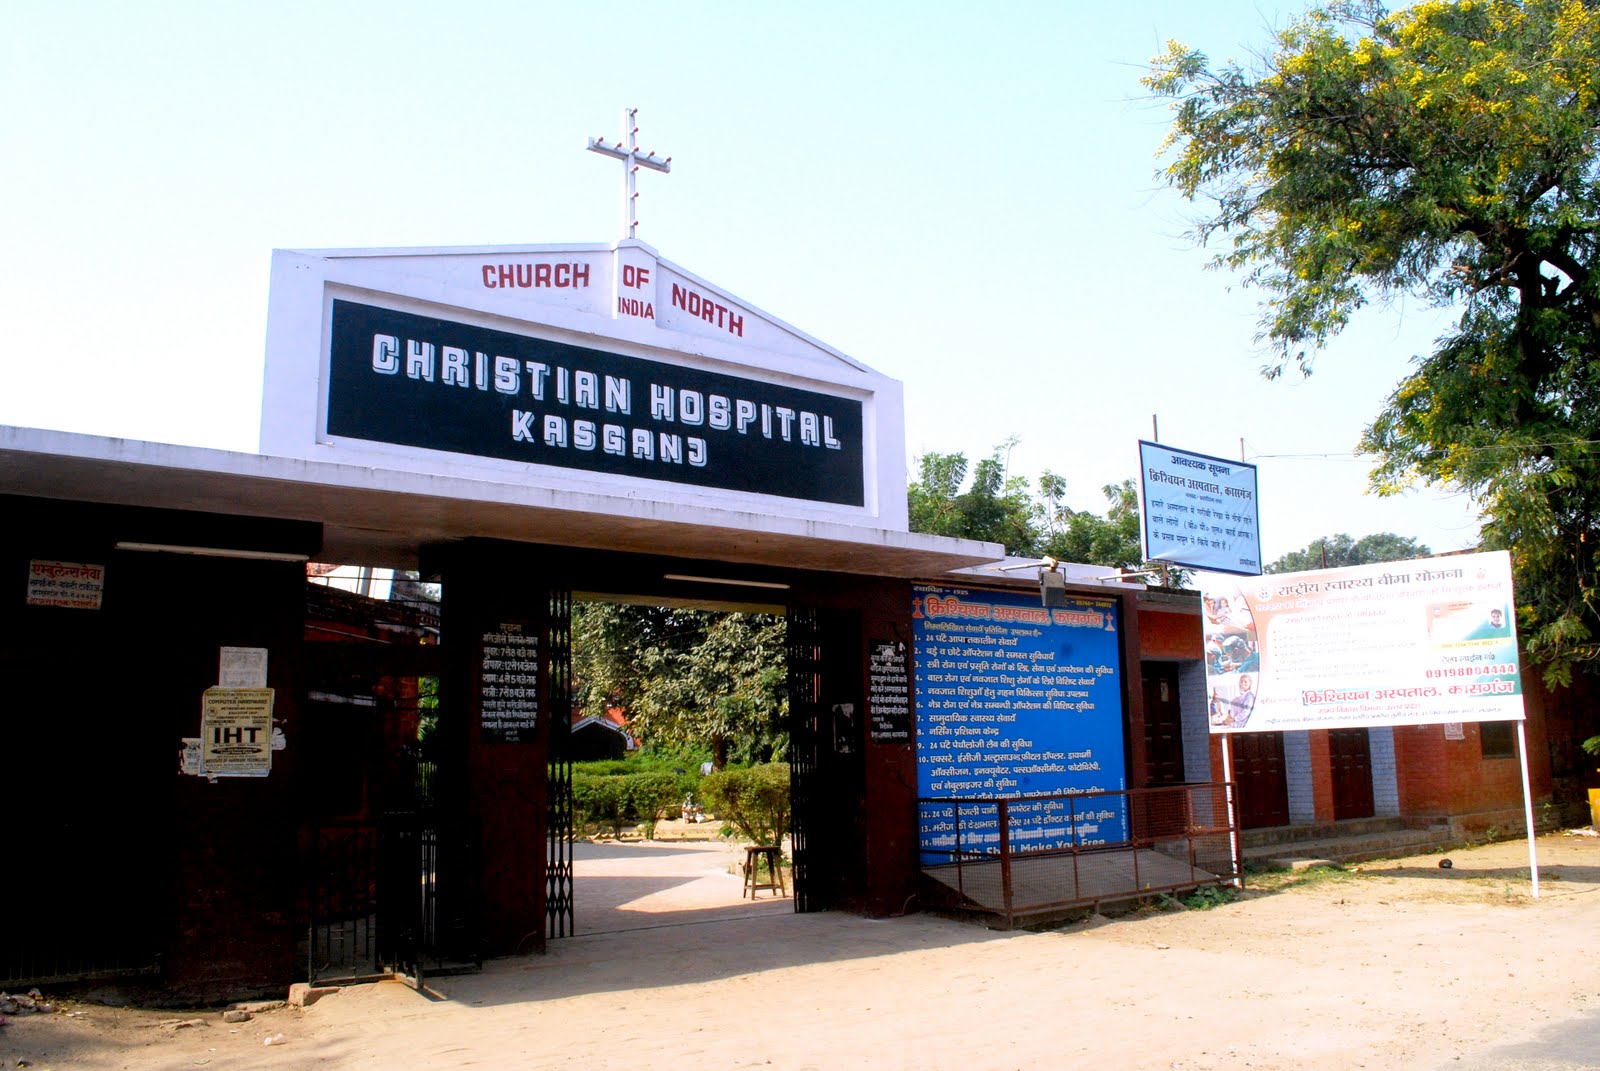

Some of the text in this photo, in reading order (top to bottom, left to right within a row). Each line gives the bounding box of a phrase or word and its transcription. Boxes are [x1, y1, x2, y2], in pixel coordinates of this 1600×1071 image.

[482, 263, 744, 338] CHURCH OF NORTH
[618, 296, 655, 320] INDIA
[371, 332, 842, 450] CHRISTIAN HOSPITAL
[511, 409, 708, 467] KASGANJ
[1171, 456, 1230, 477] आवश्यक सूचना
[1224, 487, 1252, 500] कासगंज
[1278, 568, 1463, 597] राष्ट्रीय स्वास्थ्य बीमा योजना
[925, 596, 991, 619] क्रिश्चियन
[1053, 609, 1103, 627] कासगंज
[947, 646, 960, 656] छोटे
[962, 647, 993, 658] ऑपरेशन
[994, 648, 1004, 658] की
[1006, 651, 1027, 660] समस्त
[927, 658, 940, 669] स्त्री
[942, 661, 955, 669] रोग
[957, 660, 968, 669] एवं
[970, 660, 990, 672] प्रसूति
[1007, 662, 1015, 671] के
[1032, 664, 1045, 673] सेवा
[1046, 664, 1057, 673] एवं
[1085, 664, 1094, 674] की
[1095, 665, 1114, 677] सुविधा
[1426, 664, 1516, 679] 09198004444
[927, 674, 943, 682] बाल
[944, 673, 958, 682] रोग
[960, 673, 971, 682] एवं
[972, 675, 998, 684] नवजात
[1000, 674, 1016, 687] शिशु
[1032, 676, 1041, 685] के
[1055, 676, 1078, 686] विशिष्ट
[928, 688, 956, 696] नवजात
[984, 687, 995, 700] हेतु
[997, 689, 1014, 697] गहन
[1016, 688, 1044, 698] चिकित्सा
[1045, 688, 1065, 701] सुविधा
[1304, 688, 1370, 704] क्रिश्चियन
[1448, 679, 1514, 695] कासगंज
[928, 700, 941, 709] नेत्र
[943, 700, 957, 709] रोग
[958, 700, 969, 709] एवं
[970, 700, 983, 709] नेत्र
[1042, 701, 1052, 710] की
[1053, 701, 1075, 711] विशिष्ट
[1075, 701, 1095, 713] सुविधा
[929, 712, 968, 726] सामुदायिक
[970, 714, 995, 722] स्वास्थ्य
[215, 727, 262, 743] IHT
[917, 725, 999, 737] 8. नर्सिंग प्रशिक्षण केन्द्र
[1000, 738, 1010, 748] की
[1011, 738, 1033, 751] सुविधा
[957, 752, 982, 763] ईसीजी
[931, 780, 944, 790] एवं
[983, 778, 994, 788] की
[995, 777, 1017, 790] सुविधा
[981, 804, 997, 815] पानी
[1032, 802, 1042, 811] की
[1043, 801, 1064, 814] सुविधा
[932, 821, 954, 831] मरीज
[968, 820, 997, 829] देखभाल
[1086, 811, 1095, 821] की
[1096, 809, 1115, 822] सुविधा
[987, 845, 1015, 854] Shll
[1021, 843, 1052, 853] Make
[1082, 838, 1105, 847] Free
